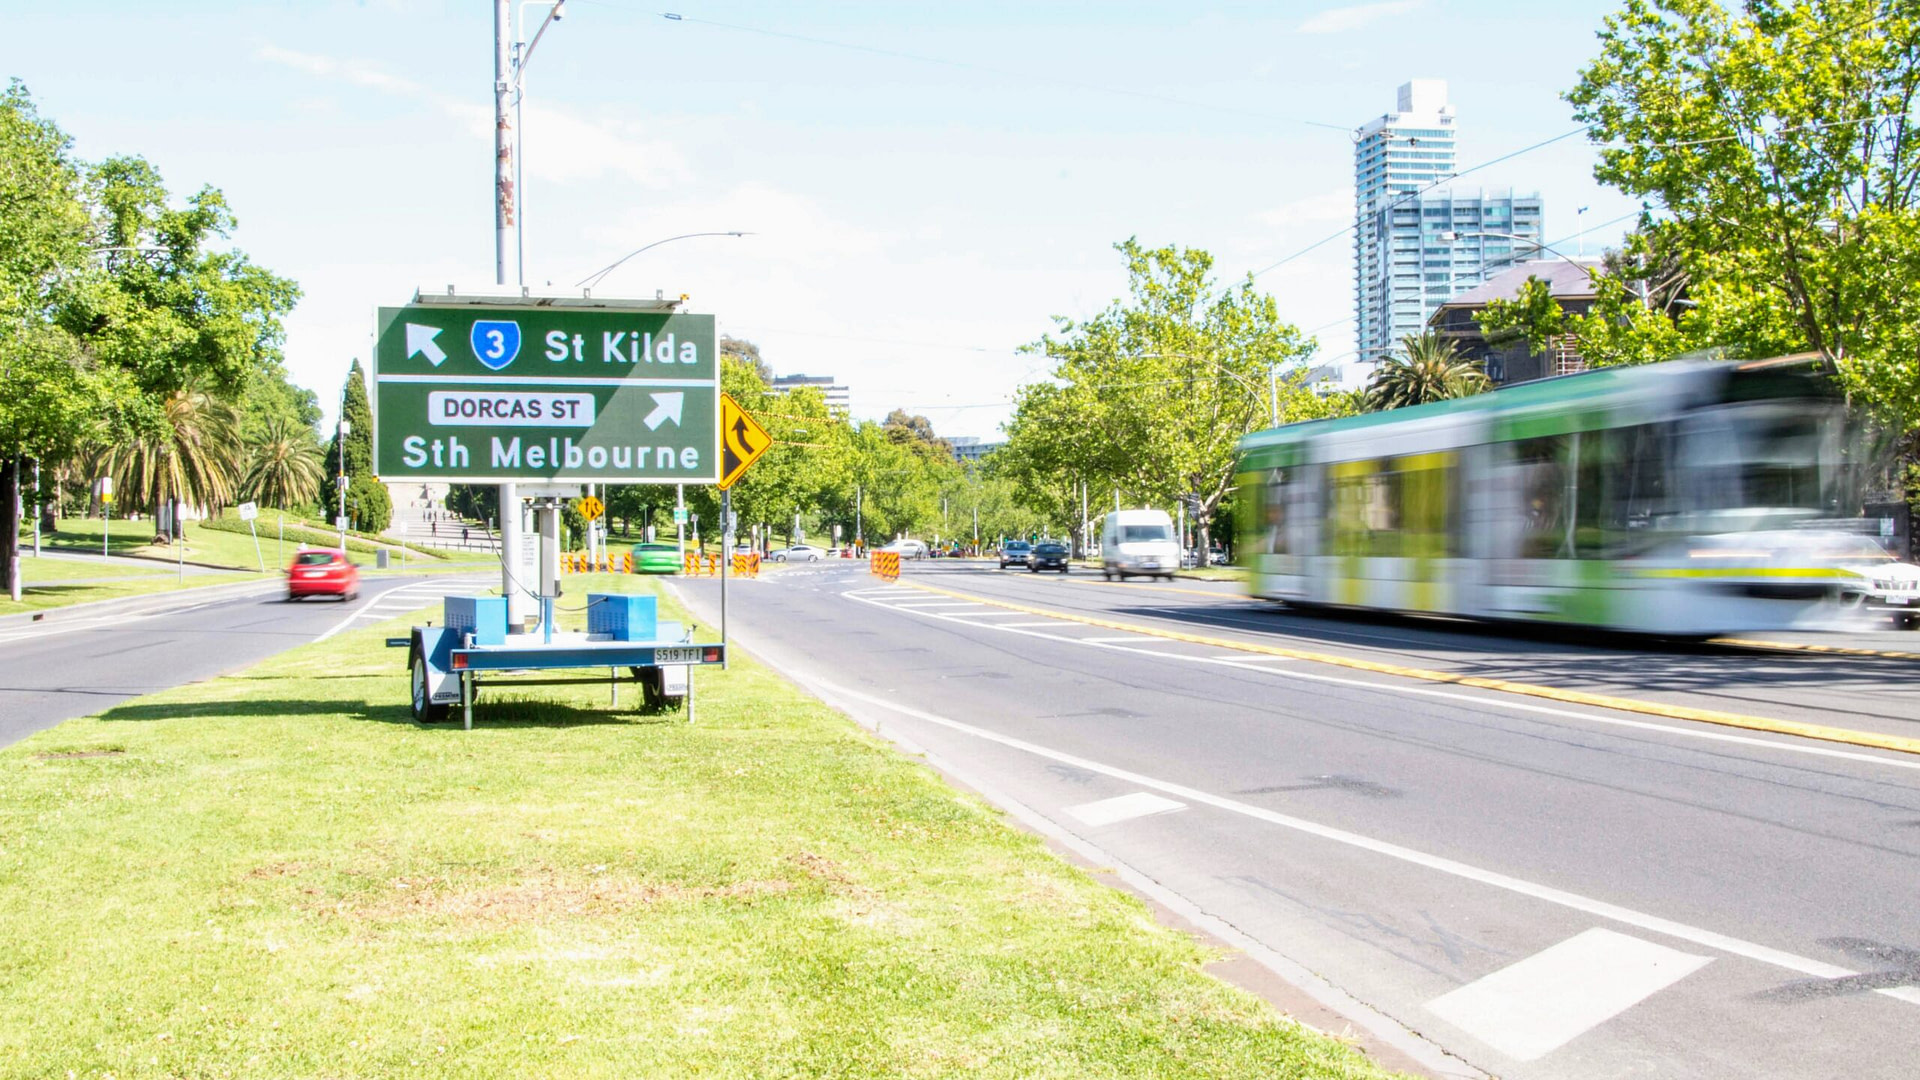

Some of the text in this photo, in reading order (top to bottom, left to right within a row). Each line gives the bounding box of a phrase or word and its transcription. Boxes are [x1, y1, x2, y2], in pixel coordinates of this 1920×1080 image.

[486, 330, 505, 358] 3
[545, 331, 698, 363] St Kilda
[444, 398, 579, 418] DORCAS ST
[403, 436, 699, 469] Sth Melbourne
[656, 650, 679, 660] S519
